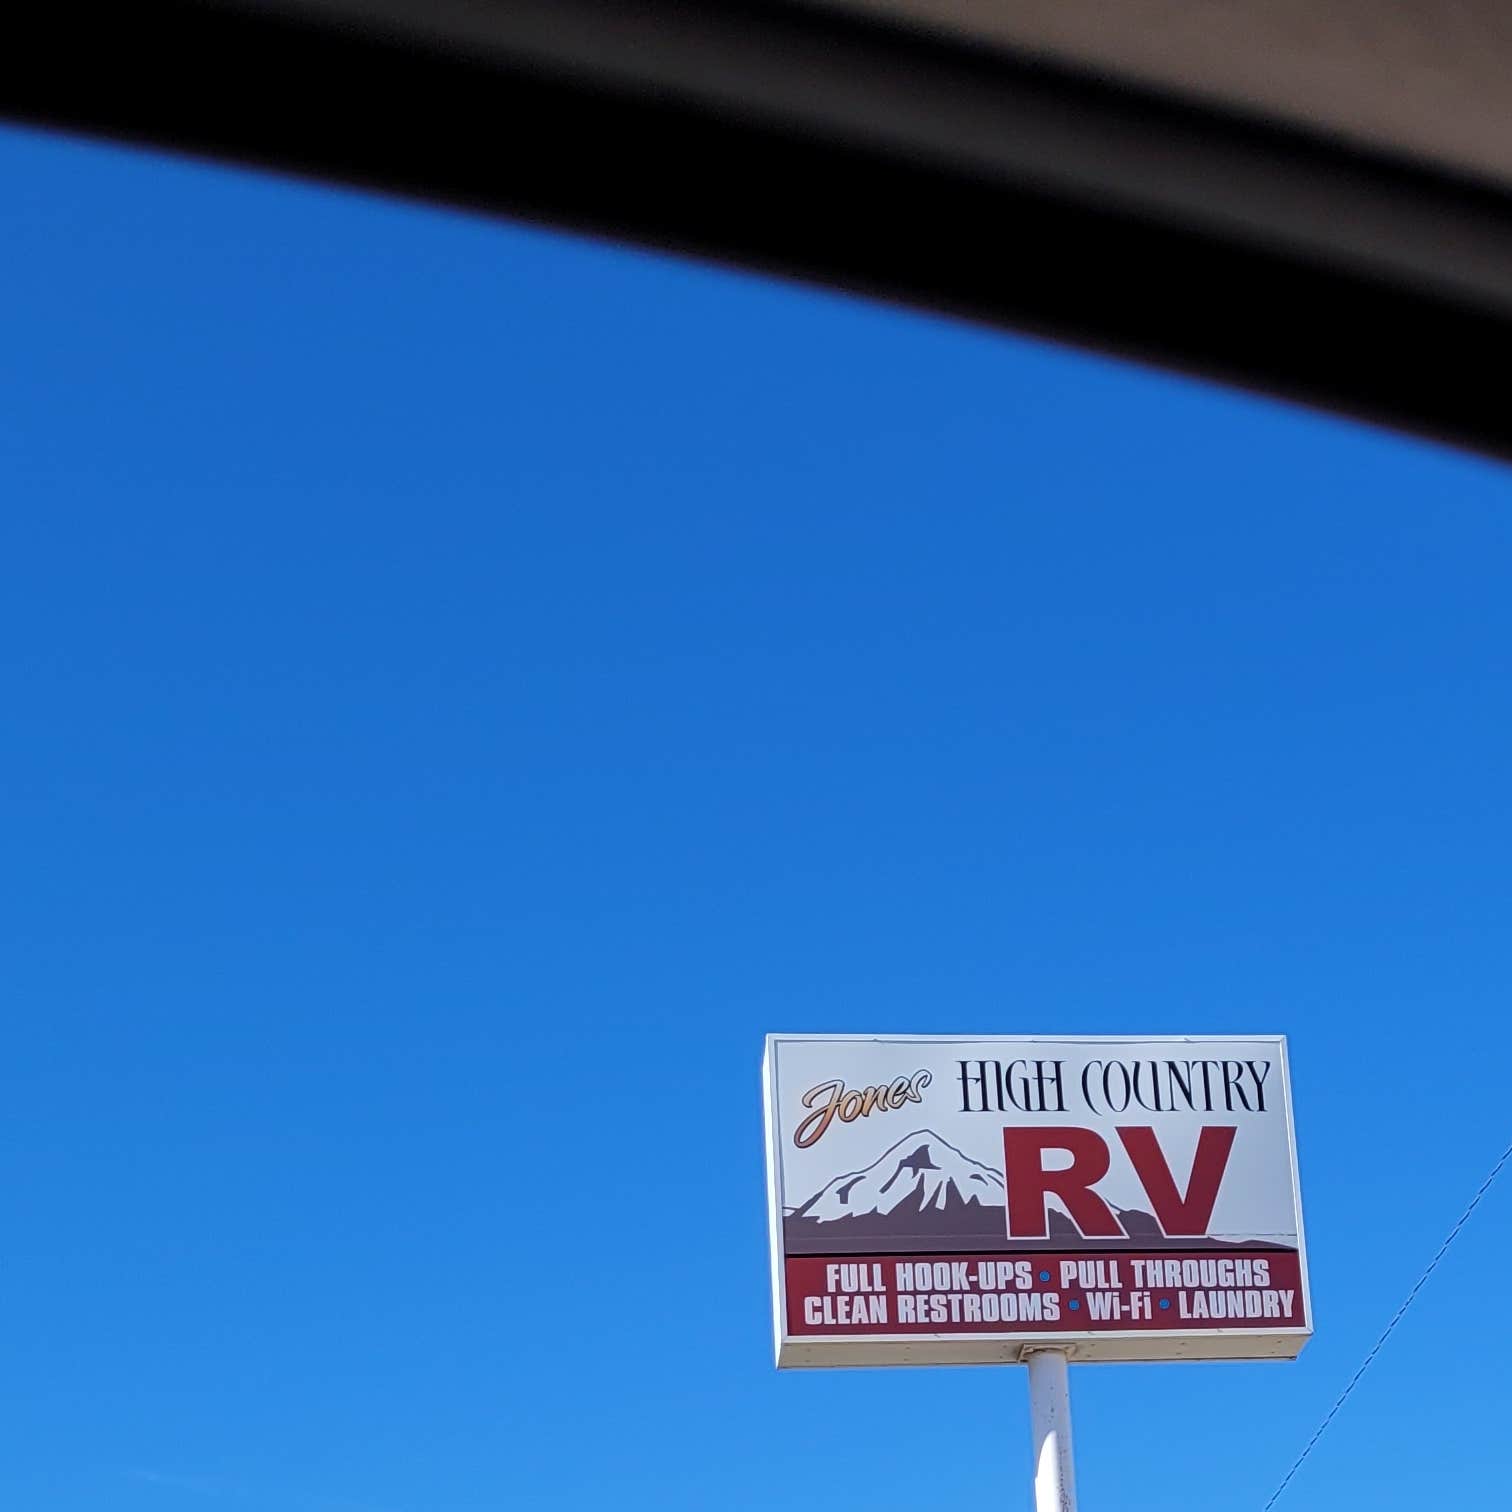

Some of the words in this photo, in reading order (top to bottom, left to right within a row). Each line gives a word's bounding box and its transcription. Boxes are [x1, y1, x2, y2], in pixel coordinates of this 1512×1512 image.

[794, 1068, 932, 1149] Jones
[955, 1060, 1066, 1113] HIGH
[1082, 1060, 1270, 1116] COUNTRY
[1002, 1126, 1238, 1240] RV
[826, 1263, 886, 1293] FULL
[896, 1261, 1033, 1291] HOOK-UPS
[1060, 1260, 1123, 1290] PULL
[1130, 1259, 1270, 1288] THROUGHS
[803, 1296, 888, 1325] CLEAN
[898, 1293, 1061, 1323] RESTROOMS
[1086, 1290, 1152, 1321] Wi-Fi
[1178, 1289, 1294, 1319] LAUNDRY
